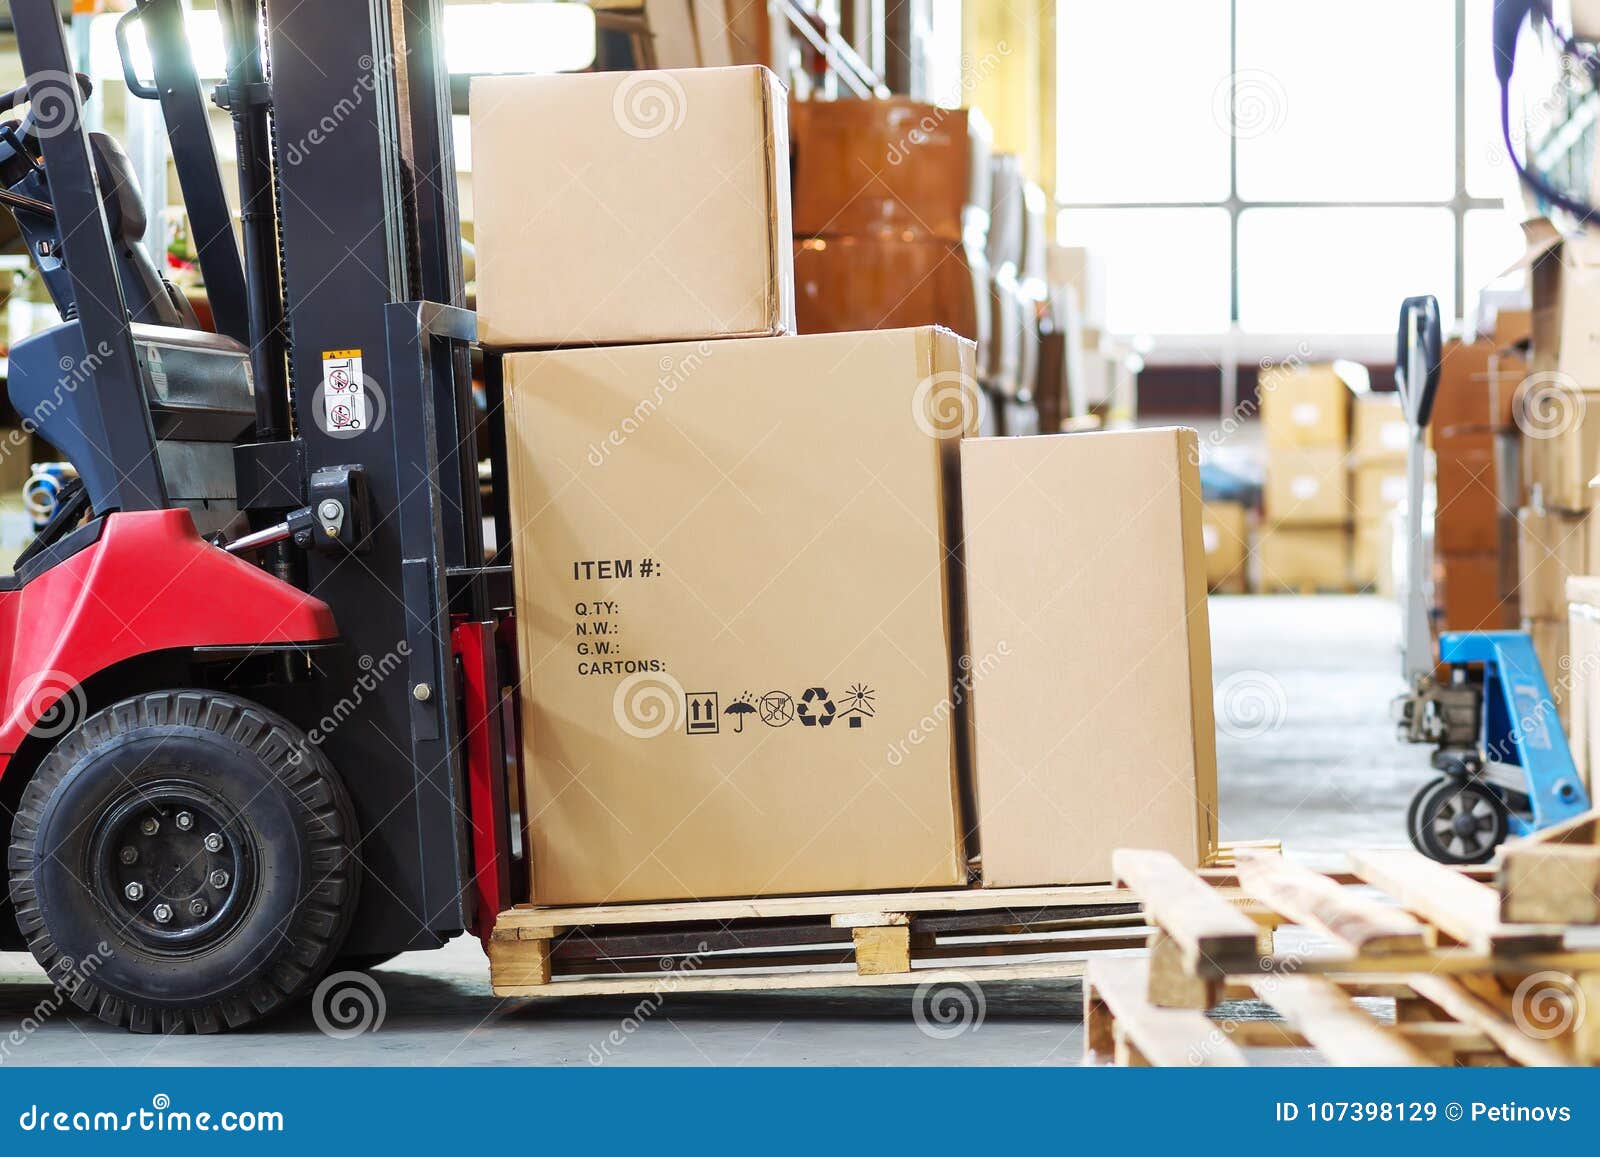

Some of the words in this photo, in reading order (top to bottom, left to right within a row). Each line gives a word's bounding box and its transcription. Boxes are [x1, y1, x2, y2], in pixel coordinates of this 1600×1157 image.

[573, 560, 633, 580] ITEM
[639, 558, 662, 578] #:
[575, 601, 619, 616] Q.TY:
[576, 621, 618, 636] N.W.:
[577, 642, 620, 656] G.W.:
[578, 659, 666, 675] CARTONS:
